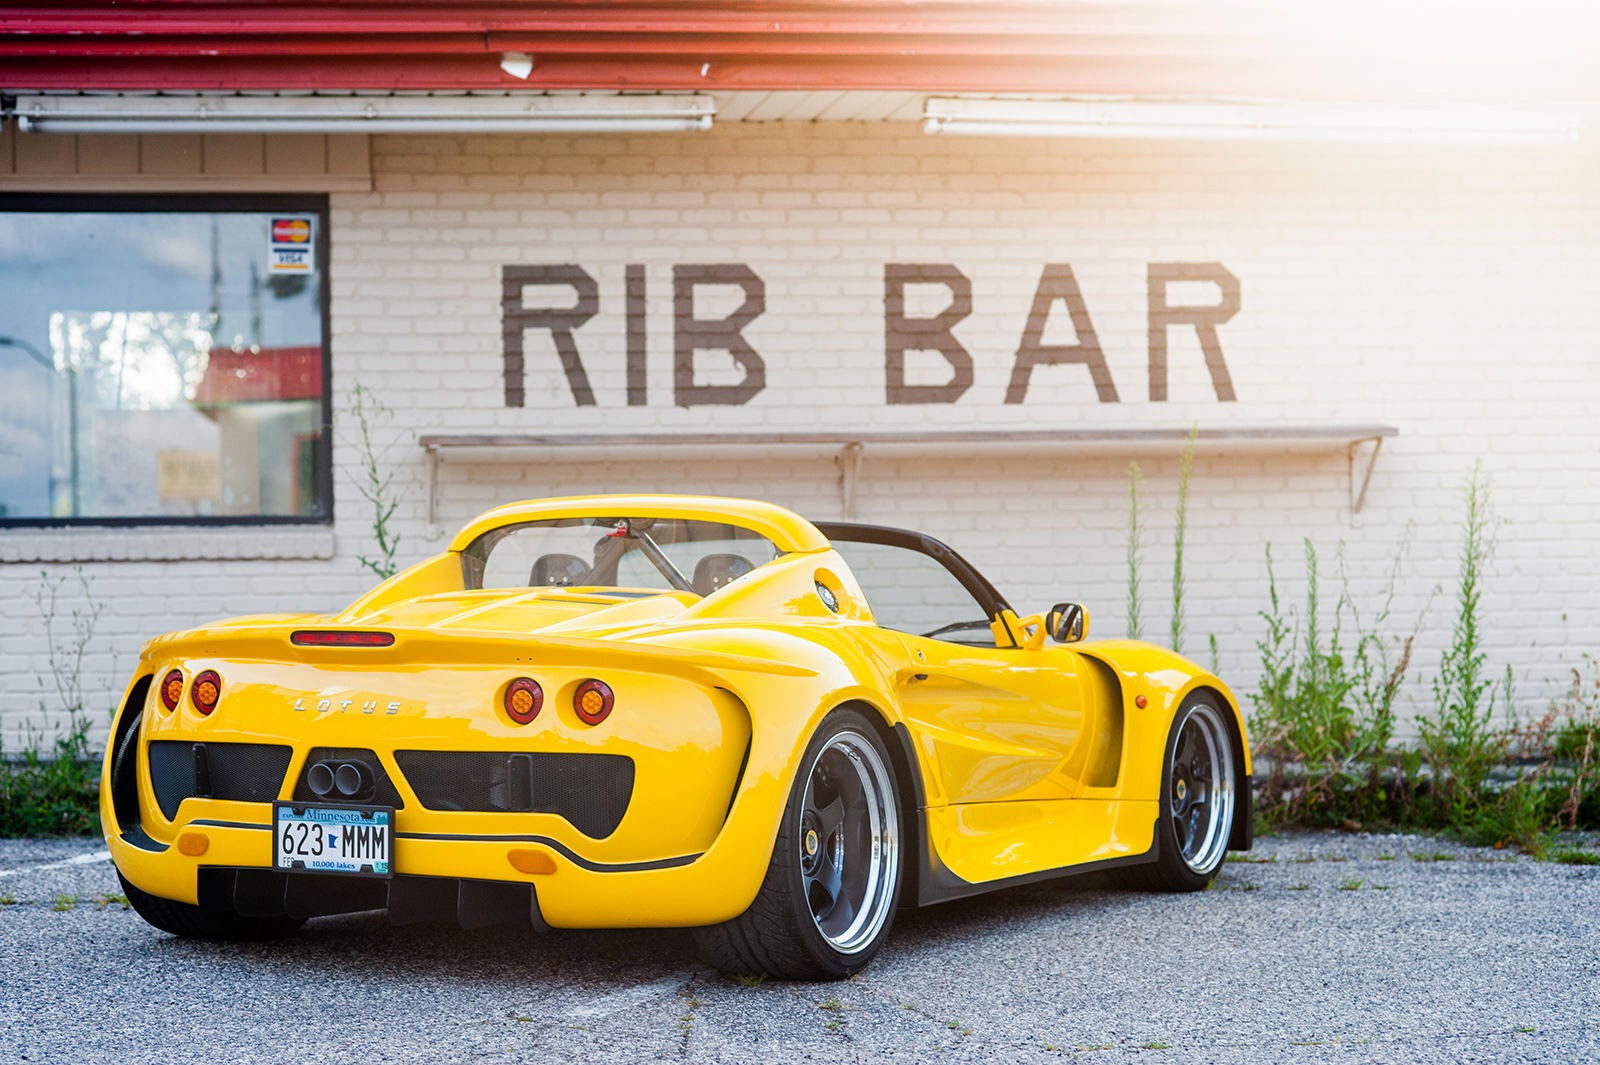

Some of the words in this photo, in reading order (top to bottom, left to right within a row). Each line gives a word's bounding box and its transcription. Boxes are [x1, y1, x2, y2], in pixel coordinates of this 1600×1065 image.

[501, 262, 766, 408] RIB
[884, 262, 1242, 405] BAR
[294, 698, 401, 715] LOTUS
[306, 809, 360, 821] Minnesota
[282, 822, 324, 856] 623
[342, 825, 385, 860] MMM
[336, 861, 356, 869] lakes
